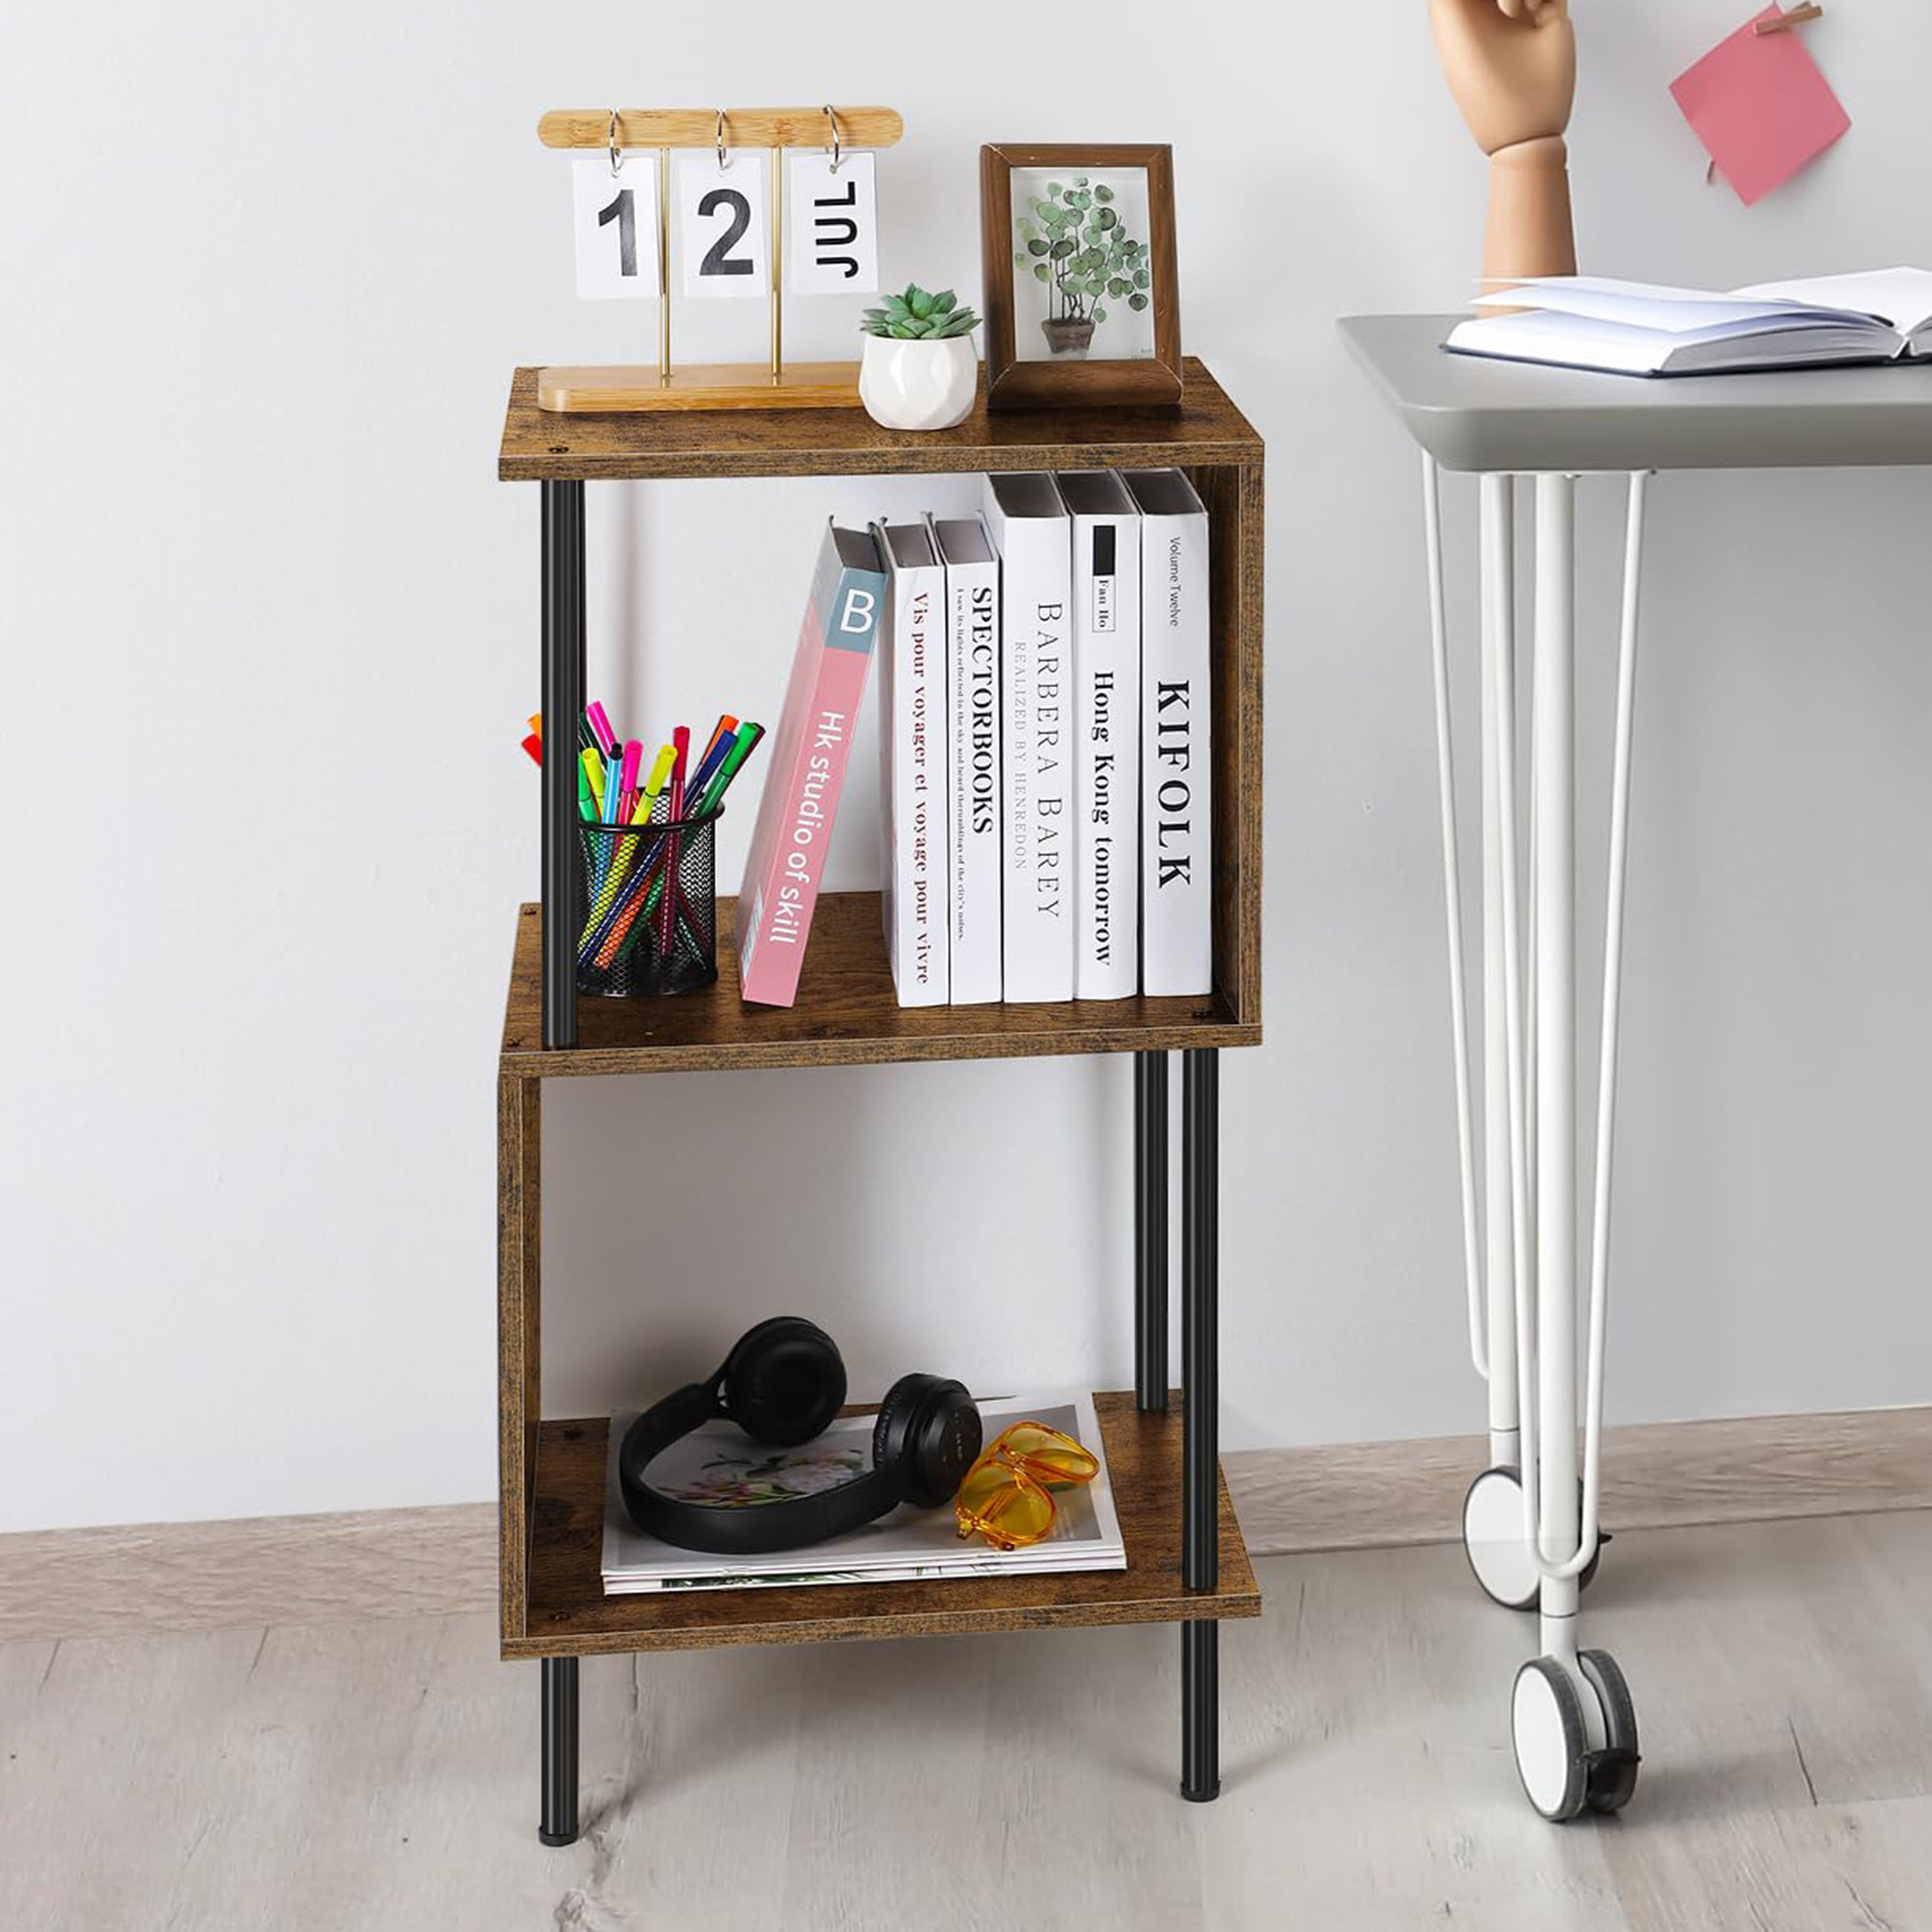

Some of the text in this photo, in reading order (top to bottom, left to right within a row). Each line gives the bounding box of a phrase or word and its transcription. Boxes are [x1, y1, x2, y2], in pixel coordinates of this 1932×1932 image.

[598, 188, 638, 277] 1
[697, 187, 754, 276] 2
[813, 181, 859, 278] JUL
[838, 588, 873, 635] B
[1098, 580, 1110, 605] Fan
[1169, 536, 1181, 627] Volume Twelve
[972, 586, 993, 835] SPECTORBOOKS
[1014, 641, 1027, 869] REALIZED BY HENREDON
[793, 754, 831, 845] studio
[912, 592, 931, 984] Vis pour voyager et voyage pour vivre
[1037, 602, 1063, 918] BARBERA BAREY
[1157, 679, 1191, 890] KIFOLK
[1092, 670, 1115, 966] Hong Kong tomorrow
[784, 852, 811, 884] of
[770, 886, 804, 944] skill
